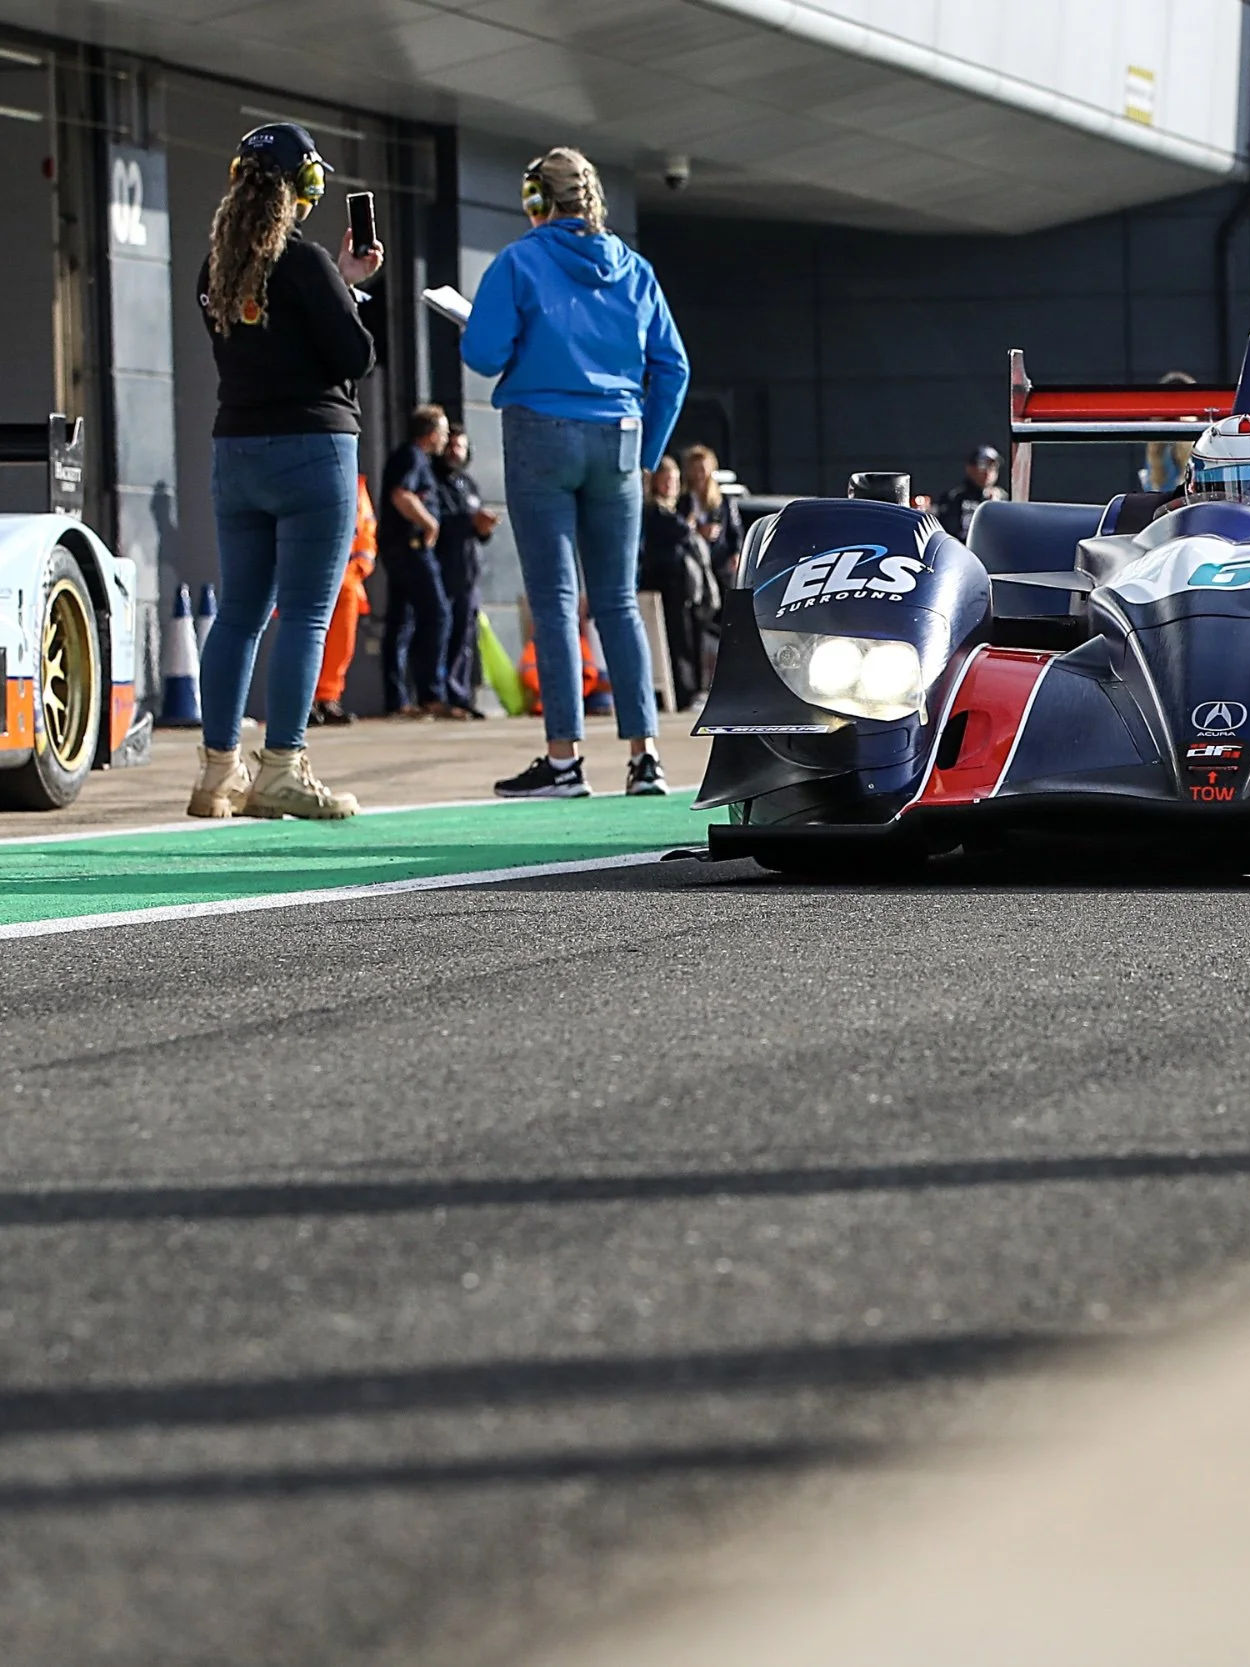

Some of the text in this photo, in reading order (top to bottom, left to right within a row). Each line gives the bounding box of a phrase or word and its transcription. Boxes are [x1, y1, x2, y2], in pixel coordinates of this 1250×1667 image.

[111, 157, 147, 246] 02
[780, 551, 926, 608] ELS
[775, 590, 903, 618] SURROUND
[731, 726, 819, 734] MICHELIN
[1189, 786, 1235, 801] TOW
